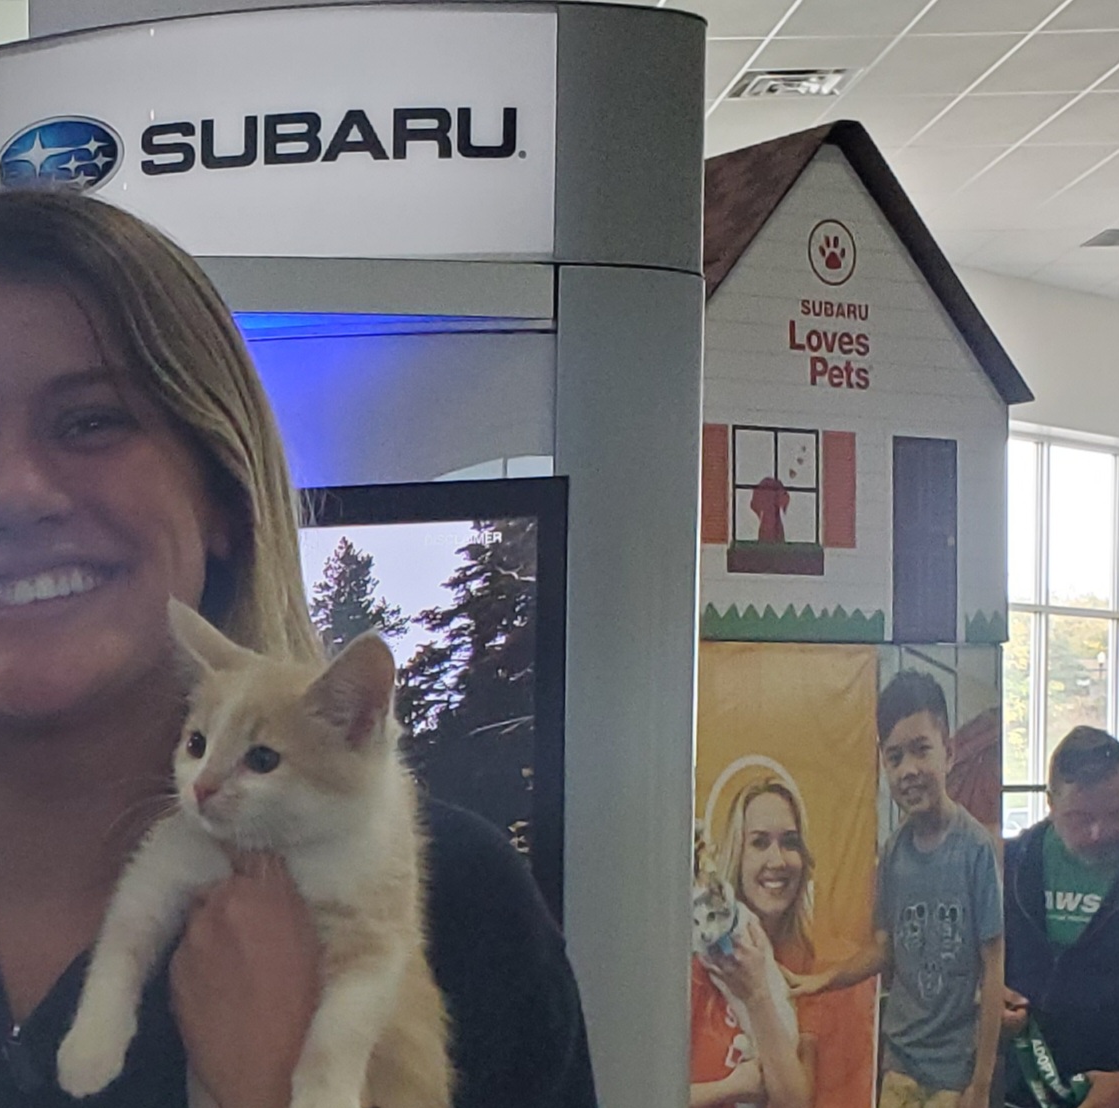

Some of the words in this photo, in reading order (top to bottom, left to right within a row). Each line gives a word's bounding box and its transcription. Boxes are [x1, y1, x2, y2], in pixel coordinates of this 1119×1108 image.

[140, 106, 518, 176] SUBARU
[800, 299, 870, 321] SUBARU
[788, 319, 870, 357] Loves
[809, 356, 871, 390] Pets
